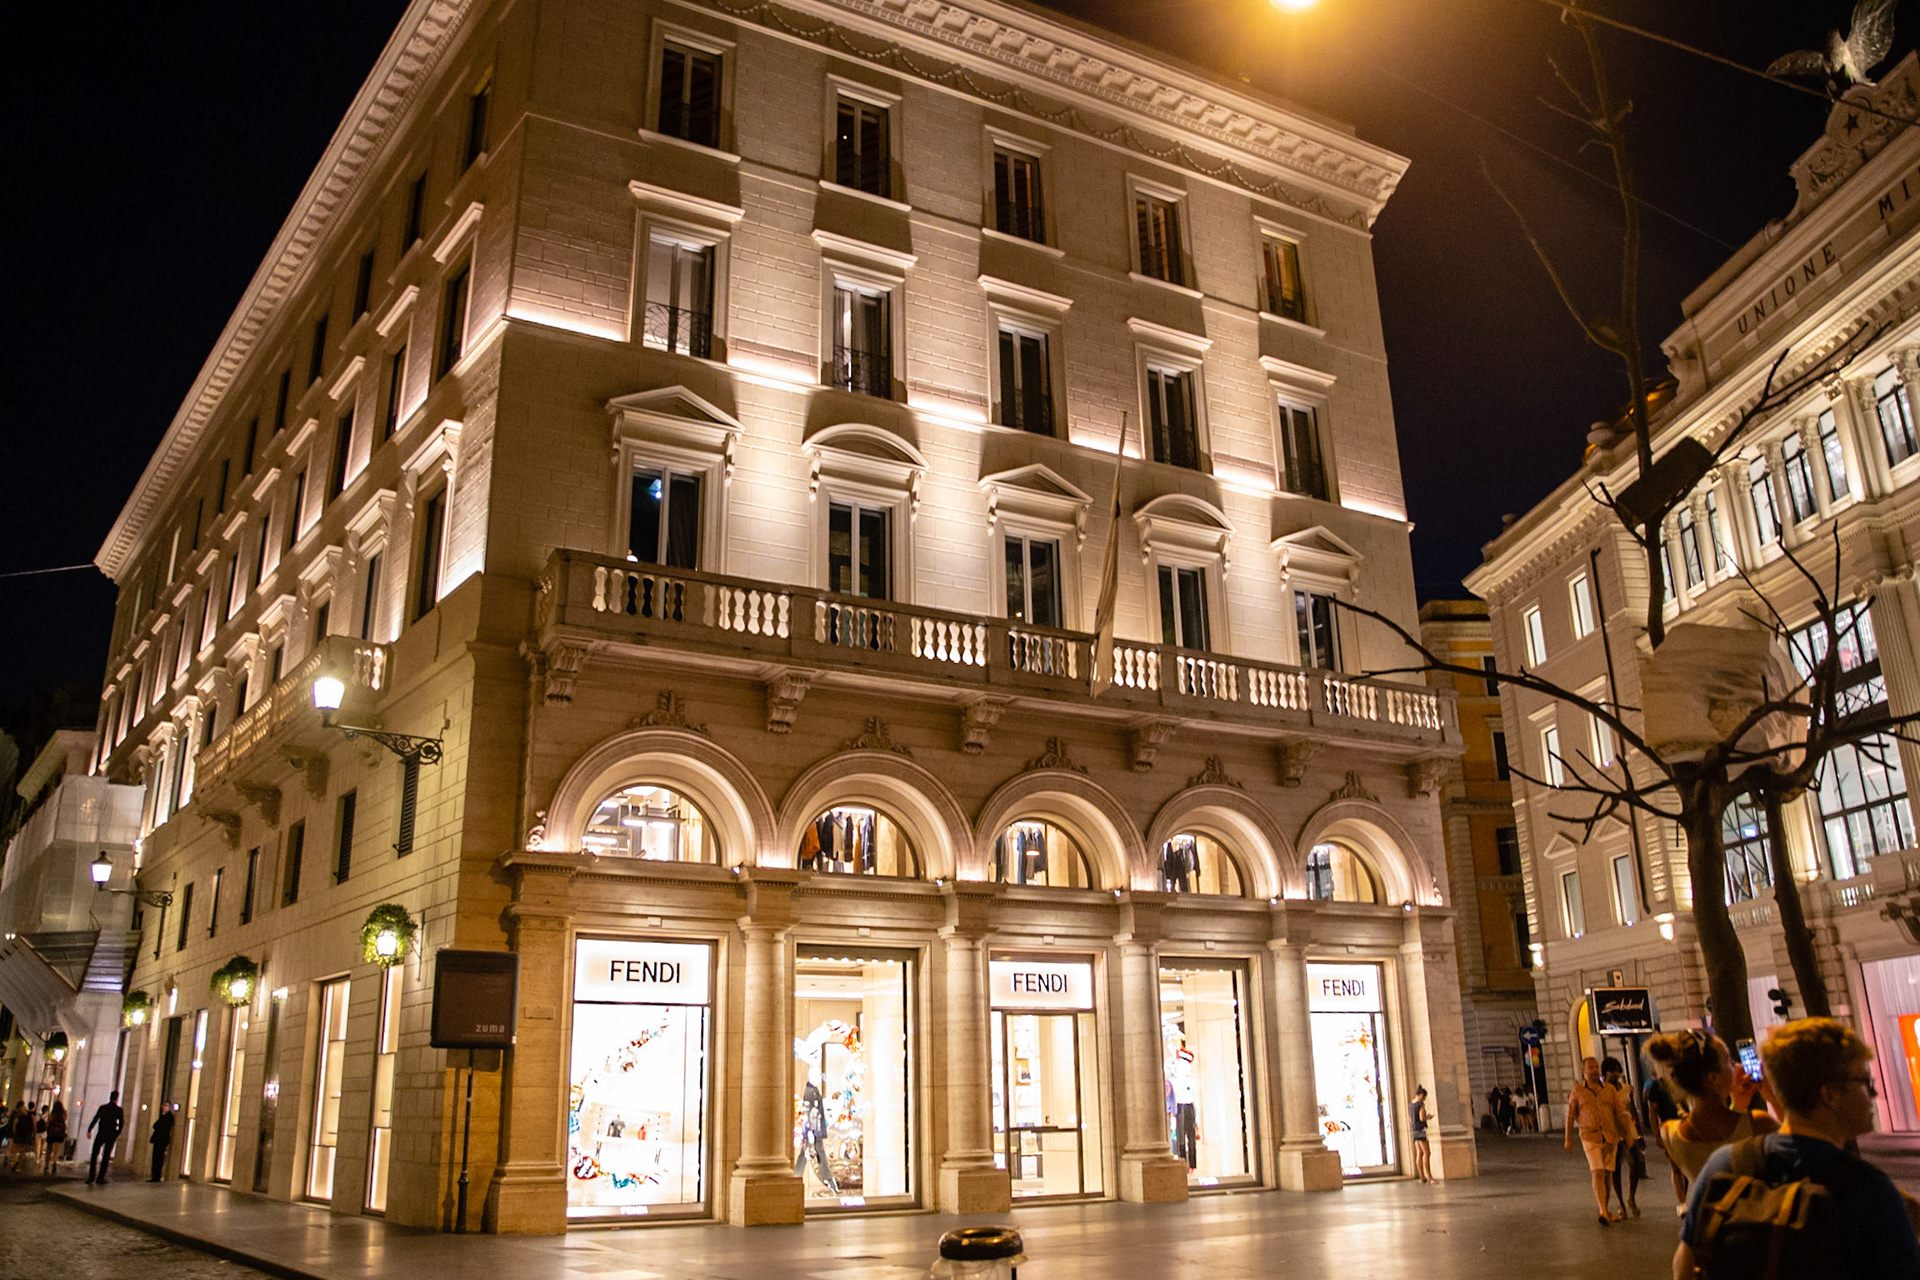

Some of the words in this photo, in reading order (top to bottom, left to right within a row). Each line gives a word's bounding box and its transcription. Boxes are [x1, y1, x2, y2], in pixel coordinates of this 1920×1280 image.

[1737, 241, 1838, 335] UNIONE
[1877, 166, 1920, 220] MI
[610, 959, 681, 984] FENDI
[1012, 972, 1068, 993] FENDI
[1322, 979, 1365, 997] FENDI
